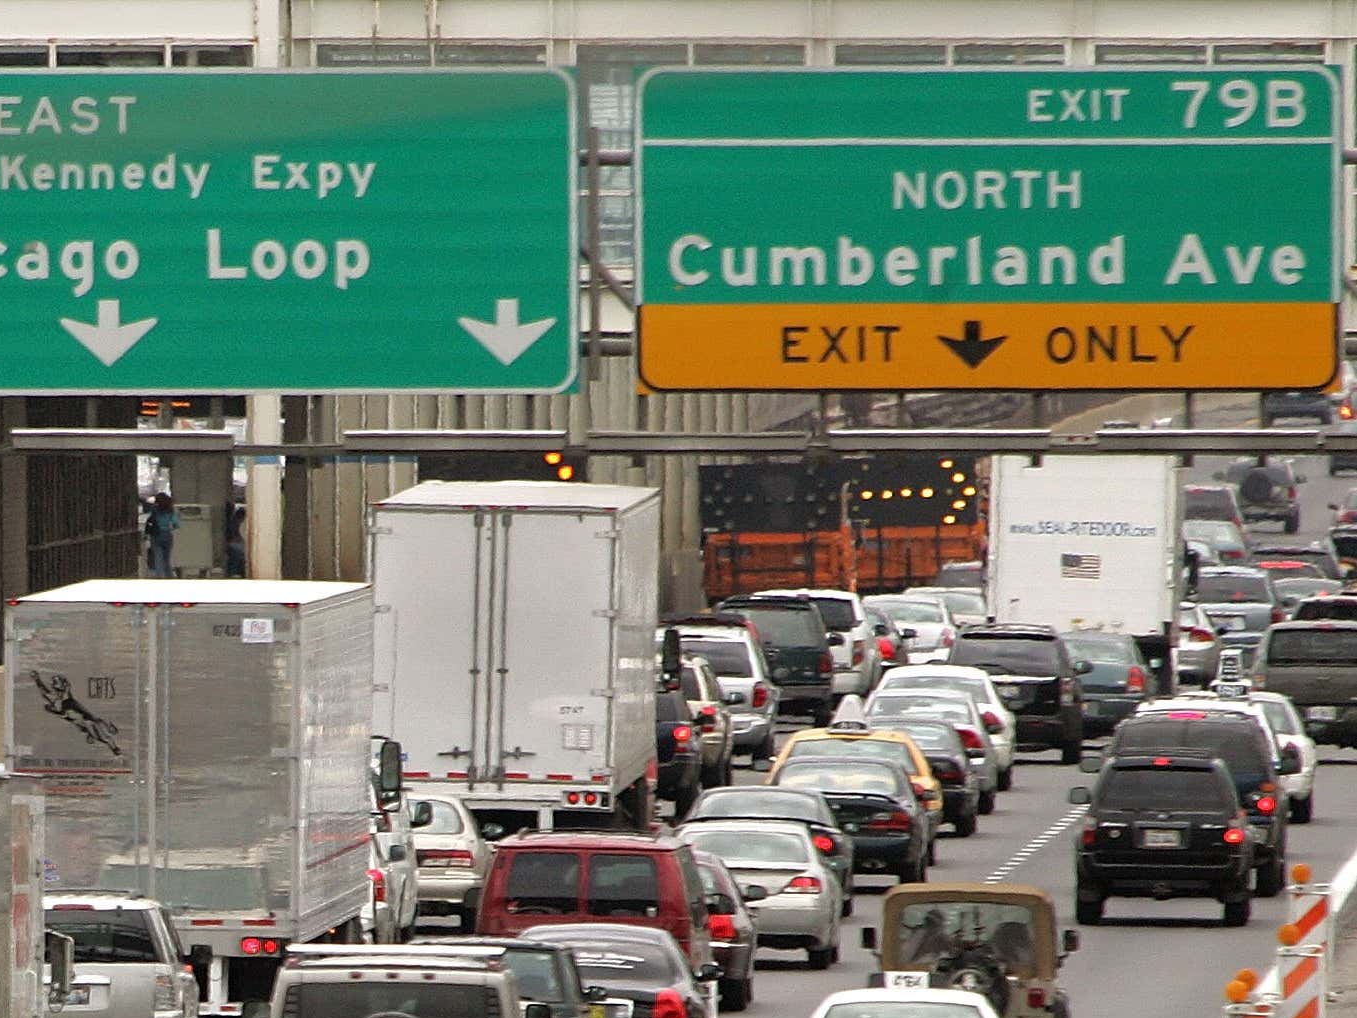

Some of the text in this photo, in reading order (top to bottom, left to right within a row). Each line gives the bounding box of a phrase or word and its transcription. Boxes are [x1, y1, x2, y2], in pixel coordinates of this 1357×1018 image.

[1027, 80, 1308, 129] EXIT 79B
[0, 153, 377, 199] Kennedy Expy
[893, 169, 1084, 210] NORTH
[206, 228, 371, 290] Loop
[667, 233, 1308, 287] Cumberland Ave
[781, 325, 1197, 363] EXIT ONLY
